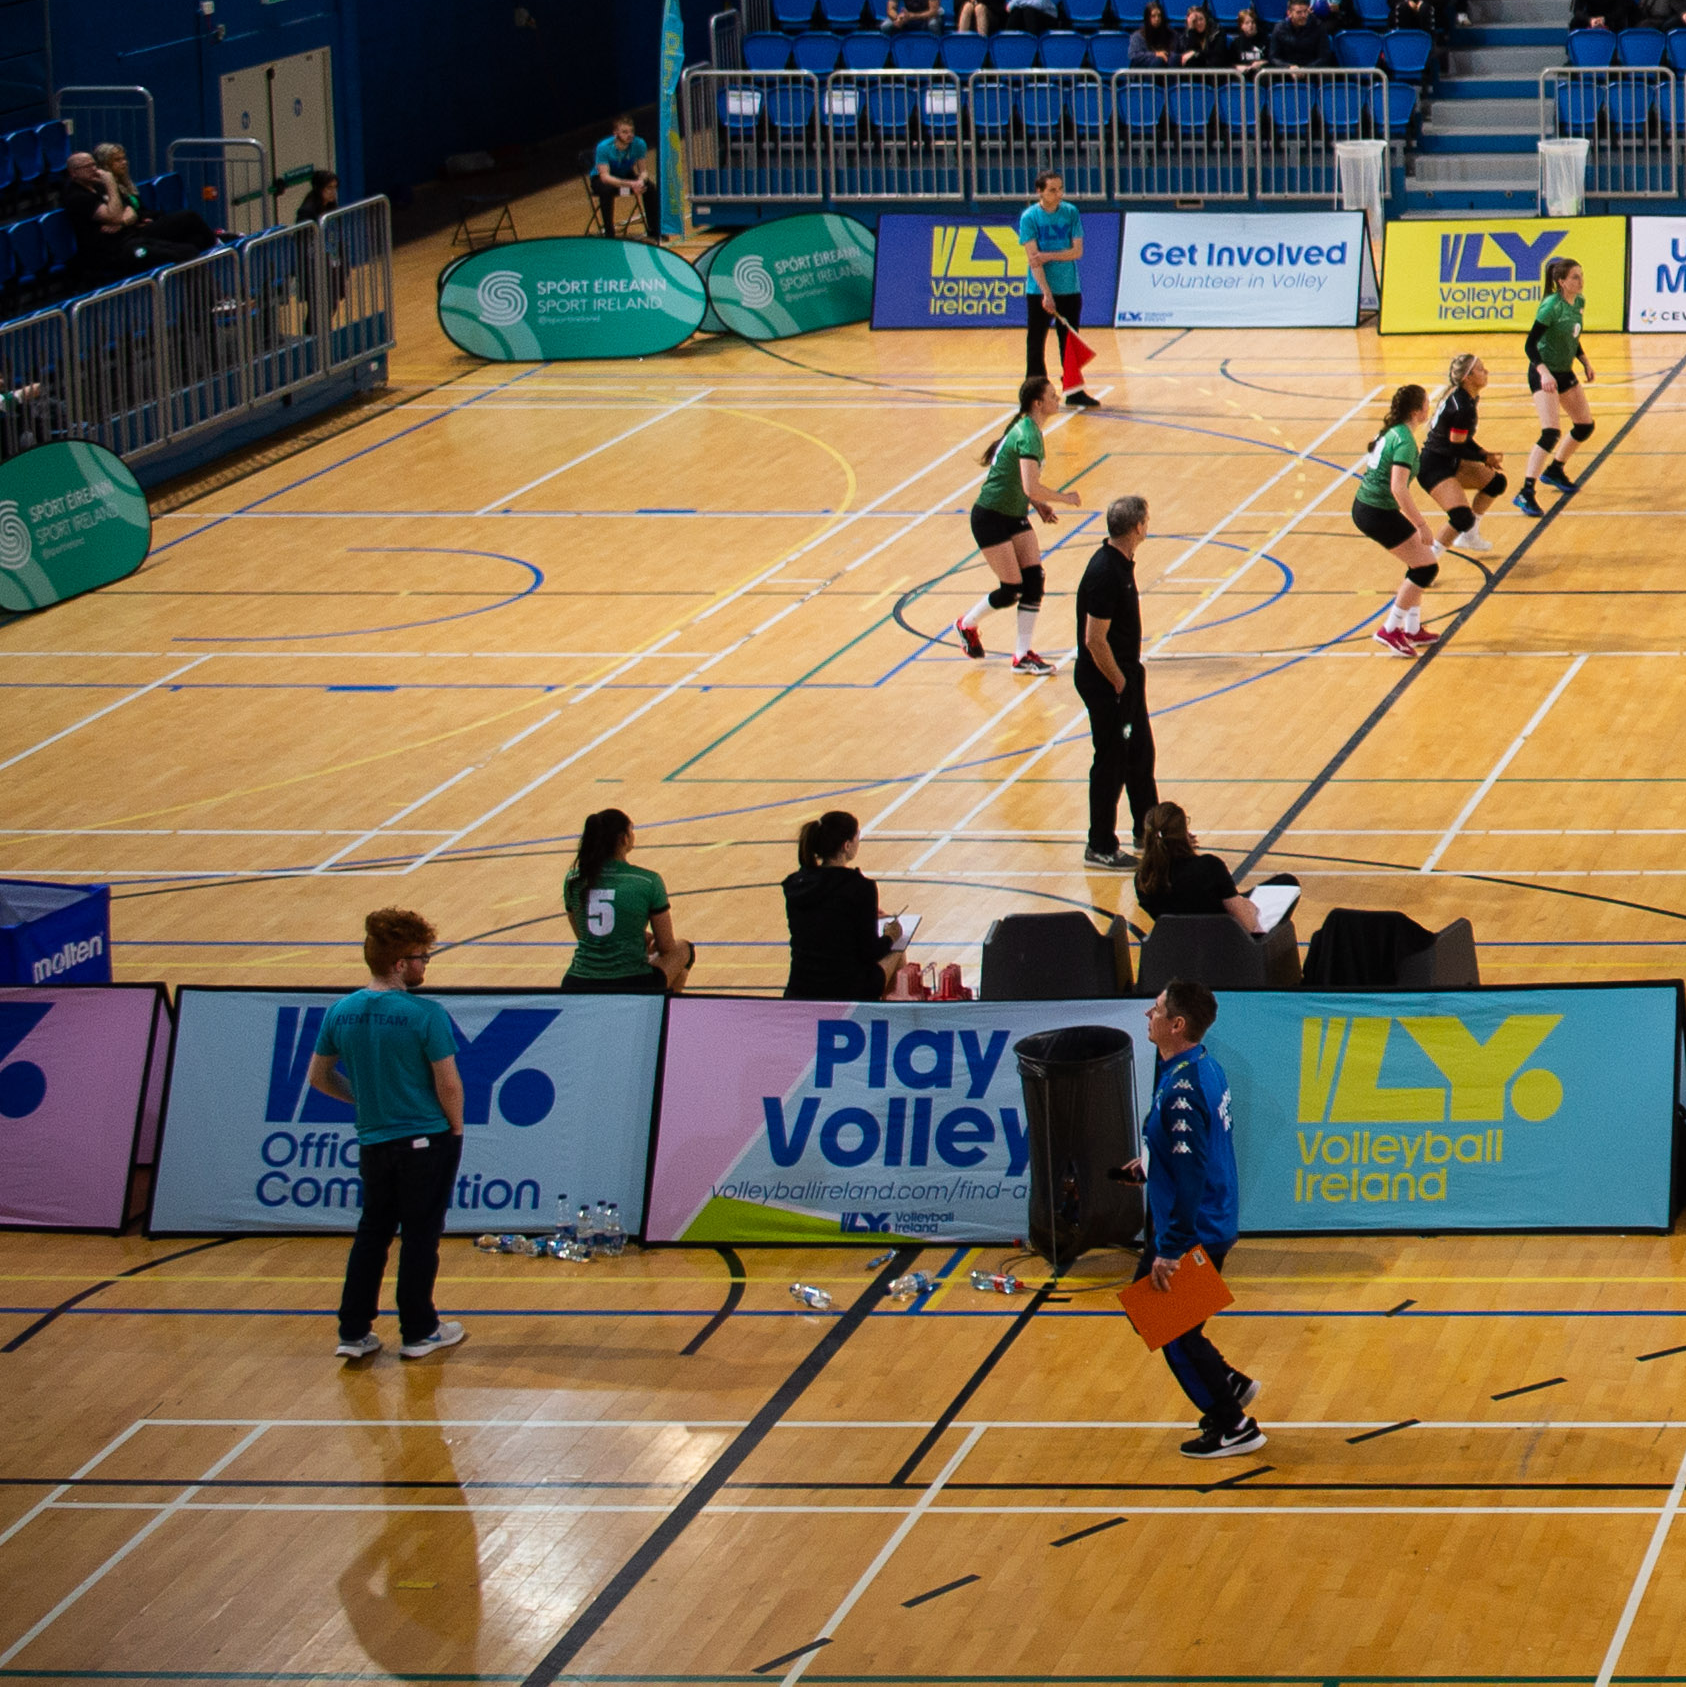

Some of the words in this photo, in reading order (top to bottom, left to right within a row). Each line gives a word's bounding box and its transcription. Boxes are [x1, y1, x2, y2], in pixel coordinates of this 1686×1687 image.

[774, 255, 811, 276] SPÓRT
[1140, 242, 1198, 266] Get
[1207, 241, 1348, 267] Involved
[537, 278, 588, 295] SPÓRT
[593, 276, 667, 294] ÉIREANN
[779, 273, 816, 292] SPORT
[817, 264, 865, 284] IRELAND
[931, 279, 1025, 301] Volleyba
[1151, 273, 1243, 289] Volunteer
[1249, 273, 1264, 288] in
[1272, 273, 1328, 291] Volley
[537, 297, 588, 315] SPORT
[593, 296, 662, 312] IRELAND
[930, 298, 1006, 316] Ireland
[1439, 285, 1541, 309] Volleyball
[1439, 302, 1514, 320] Ireland
[36, 519, 72, 546] SPORT
[587, 889, 616, 936] 5
[33, 932, 104, 984] molten
[336, 1013, 370, 1026] EVENT
[373, 1013, 409, 1027] TEAM
[815, 1019, 1010, 1097] Play
[763, 1095, 1030, 1177] Volley
[1297, 1129, 1503, 1173] Volleyball
[255, 1170, 541, 1210] Comtion
[1295, 1168, 1447, 1203] Ireland
[893, 1222, 939, 1234] Ireland
[894, 1211, 955, 1225] Volleyball
